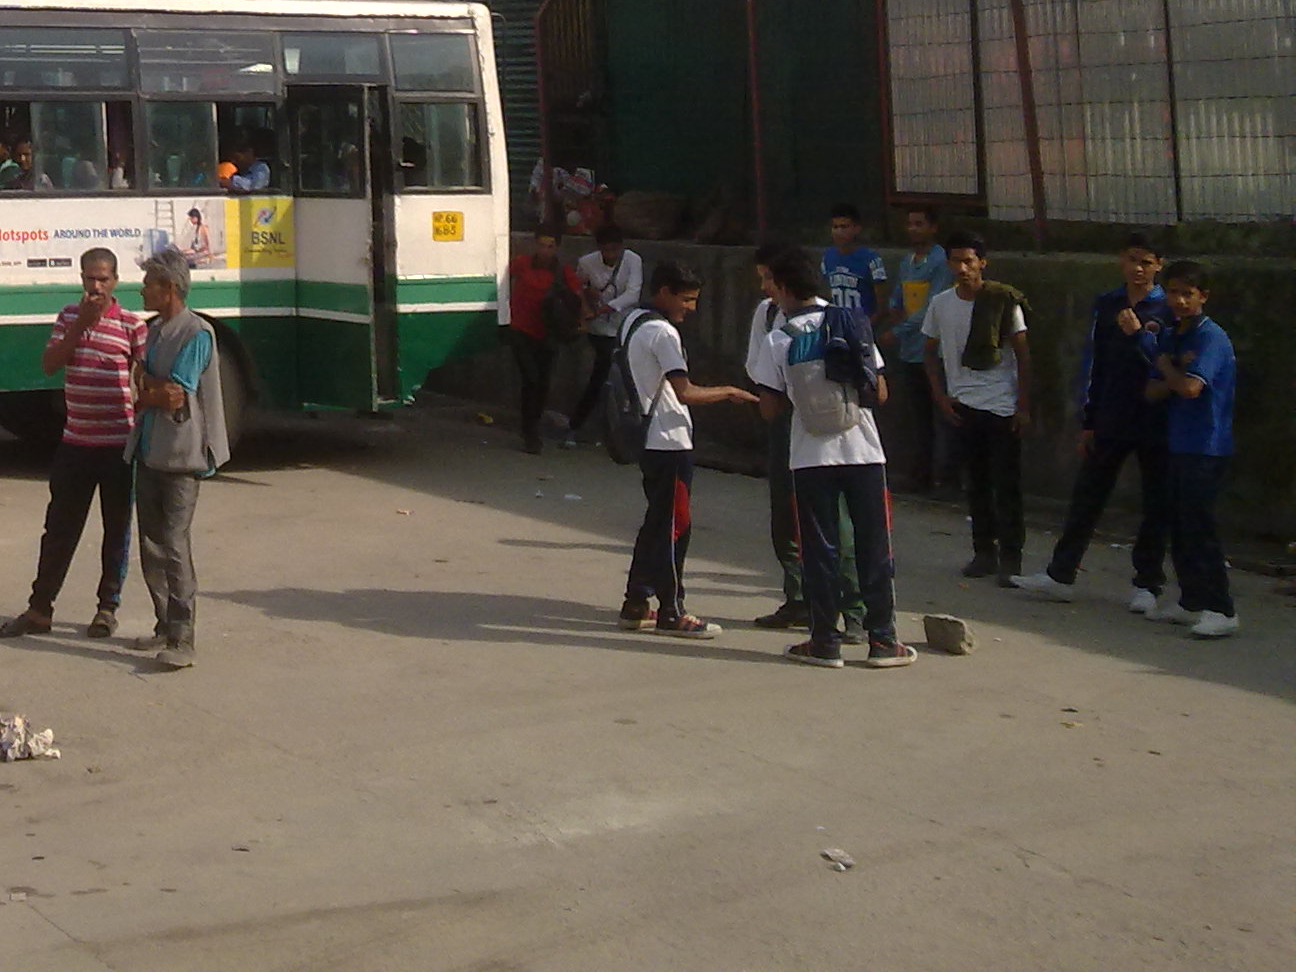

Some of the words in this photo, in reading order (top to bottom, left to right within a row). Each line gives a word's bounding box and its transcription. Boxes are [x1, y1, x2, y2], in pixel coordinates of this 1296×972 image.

[53, 229, 91, 238] AROUND
[92, 229, 108, 238] THE
[109, 228, 141, 238] WORLD
[251, 231, 286, 244] BSNL
